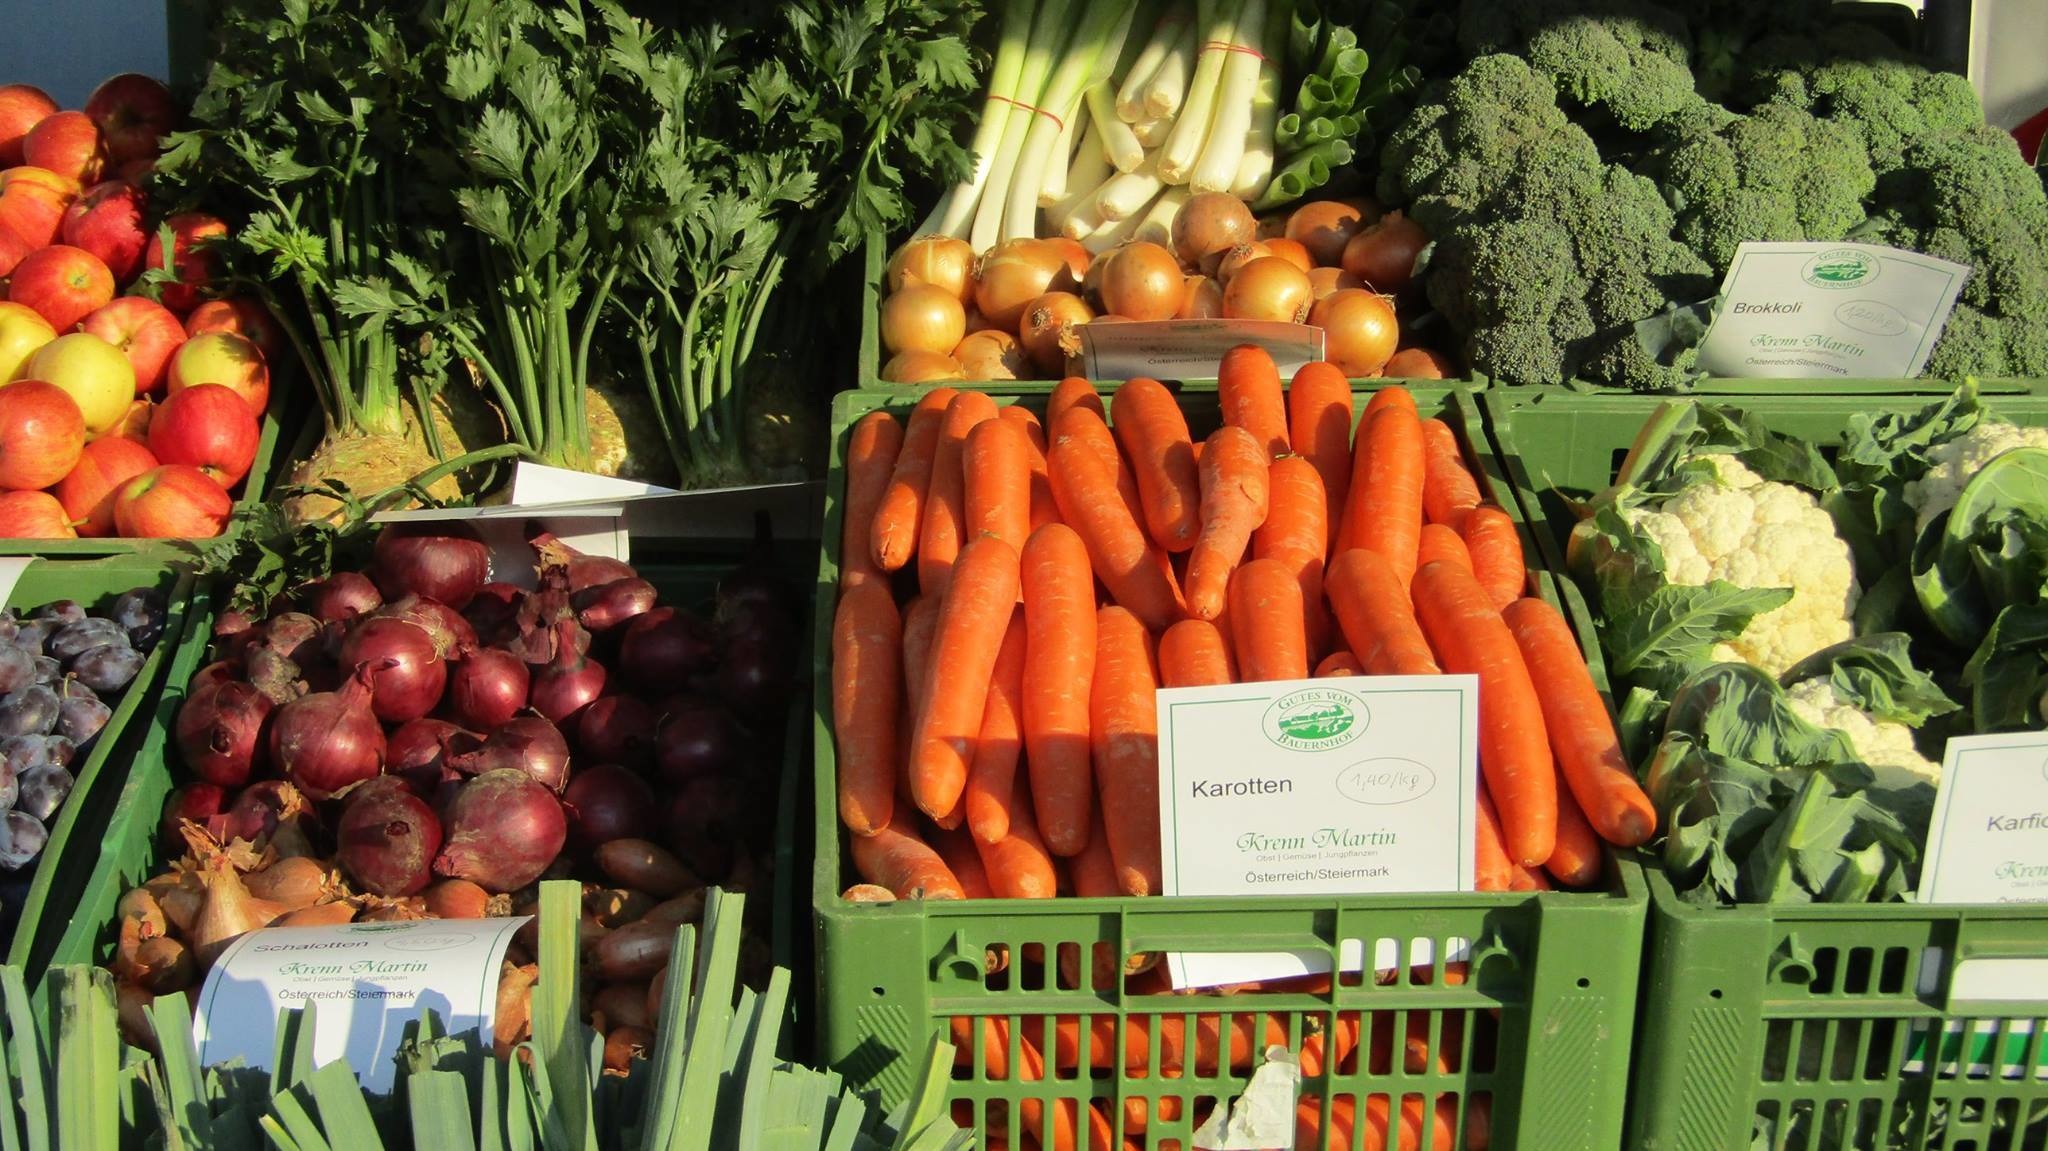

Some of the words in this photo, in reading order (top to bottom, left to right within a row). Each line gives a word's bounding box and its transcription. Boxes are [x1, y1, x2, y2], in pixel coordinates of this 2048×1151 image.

[1733, 302, 1803, 314] Brokkoli
[1750, 333, 1798, 347] Krenn
[1802, 333, 1865, 357] Martin
[1278, 692, 1321, 710] GUTES
[1326, 692, 1353, 706] VOM
[1276, 731, 1353, 750] BAUERNHOF
[1192, 777, 1293, 798] Karotten
[1236, 832, 1305, 852] Krenn
[1311, 828, 1397, 849] Martin
[1245, 866, 1390, 884] Österreich/Steiermark
[253, 940, 369, 952] Schalotten
[278, 962, 342, 975] Krenn
[348, 959, 429, 974] Martin
[278, 988, 416, 1000] Österreich/Steiermark
